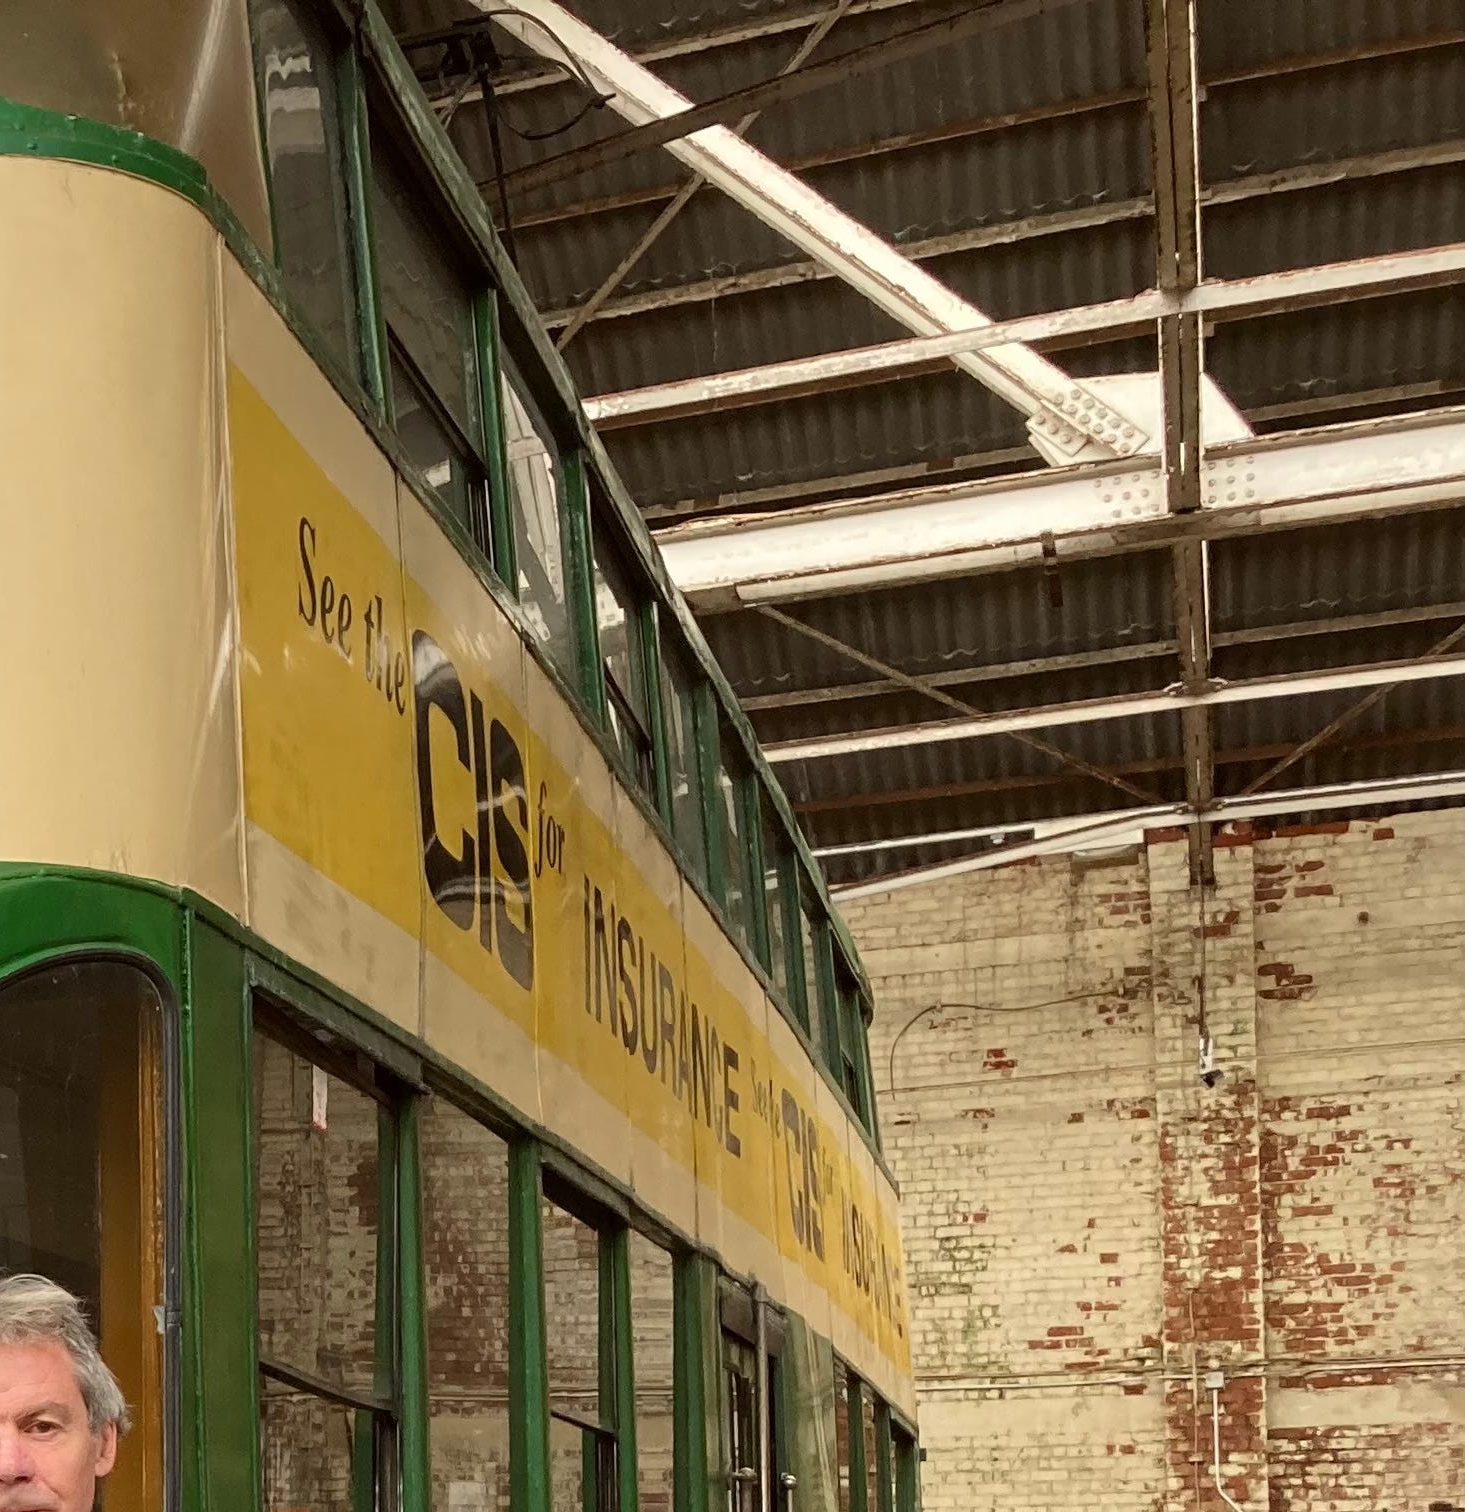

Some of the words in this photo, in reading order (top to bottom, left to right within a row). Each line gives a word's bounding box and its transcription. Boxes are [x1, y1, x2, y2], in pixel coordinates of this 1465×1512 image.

[297, 515, 353, 657] See
[364, 594, 407, 716] the
[411, 628, 535, 991] CIS
[533, 780, 567, 880] for
[584, 872, 742, 1159] INSURANCE
